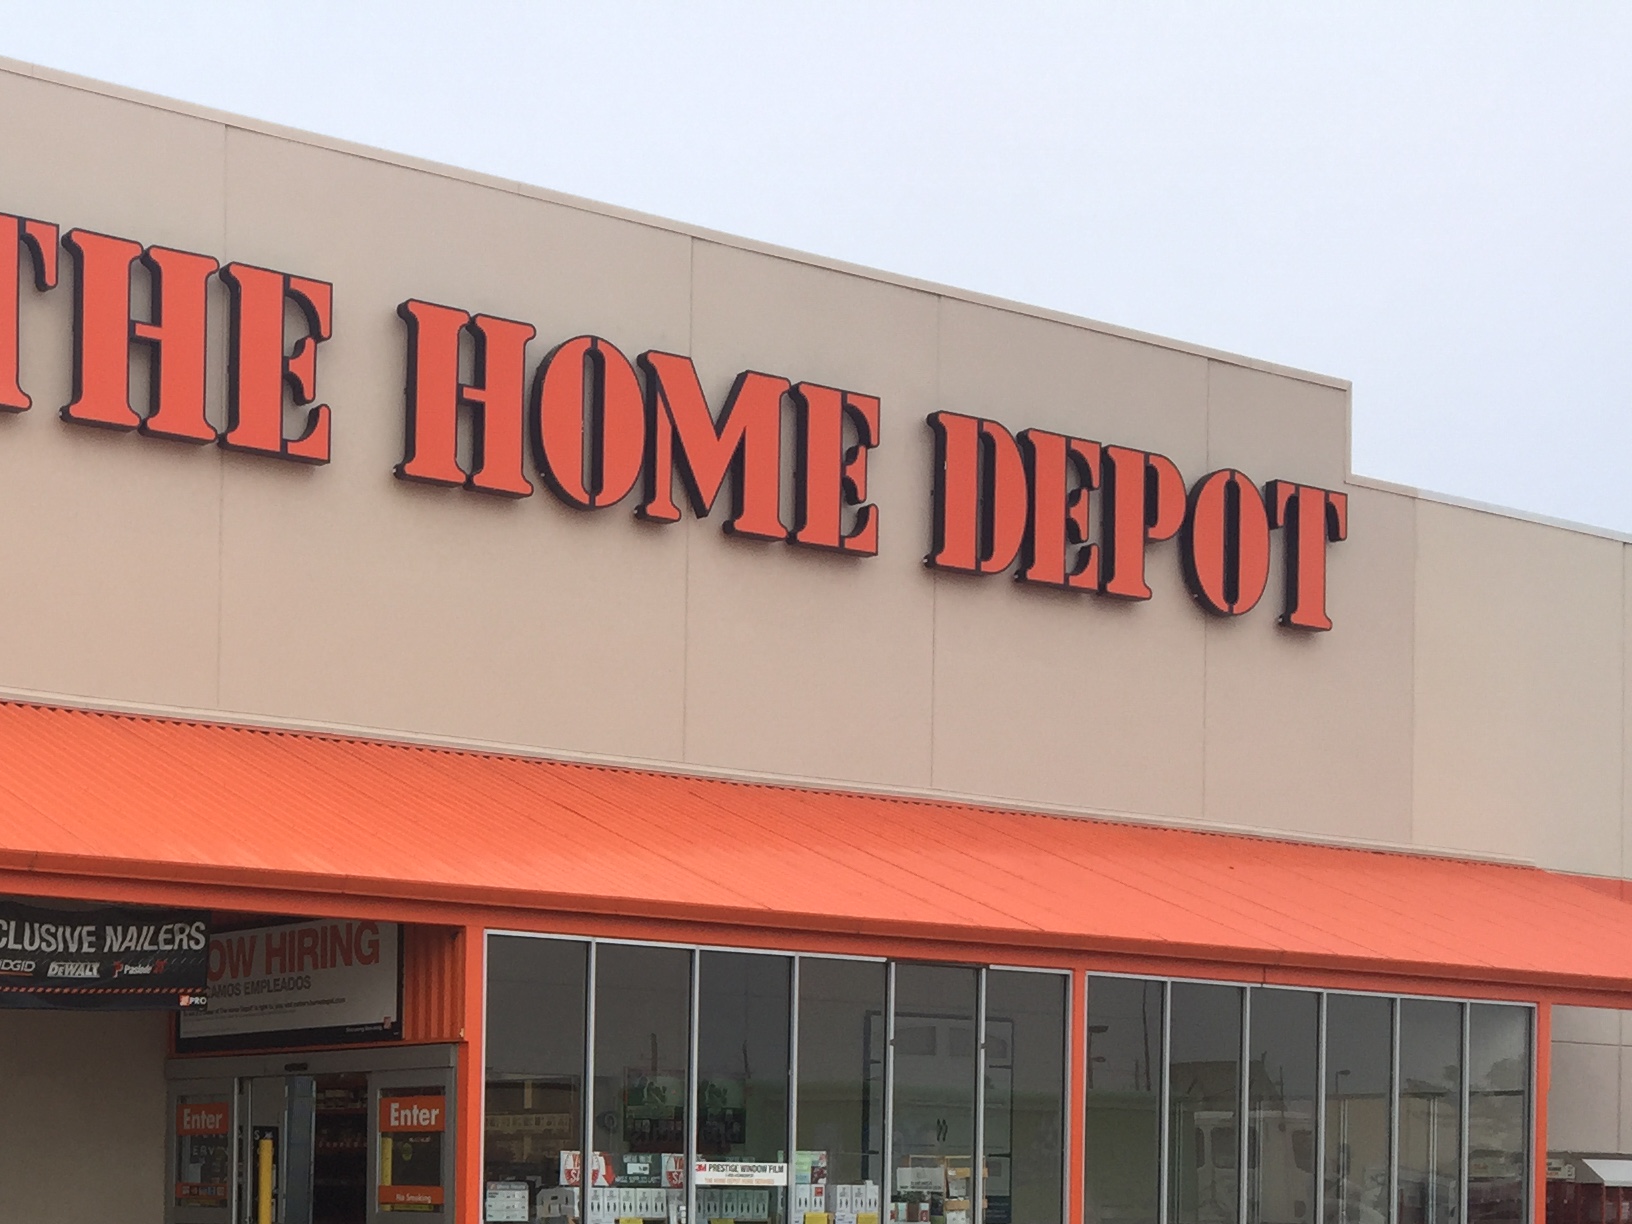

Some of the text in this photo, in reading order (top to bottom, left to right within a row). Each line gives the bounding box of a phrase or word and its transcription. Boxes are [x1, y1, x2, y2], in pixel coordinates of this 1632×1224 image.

[393, 298, 880, 557] HOME
[924, 410, 1348, 632] DEPOT
[103, 922, 206, 951] NAILERS
[208, 921, 380, 982] OW HIRING
[206, 975, 312, 999] CAMOS EMPLEADOS
[189, 996, 207, 1006] PRO
[183, 1108, 223, 1130] Enter
[390, 1103, 440, 1127] Enter
[709, 1164, 739, 1173] PRESTIGE
[740, 1165, 767, 1173] WINDOW
[769, 1165, 784, 1173] FILM
[406, 1193, 432, 1204] Smoking
